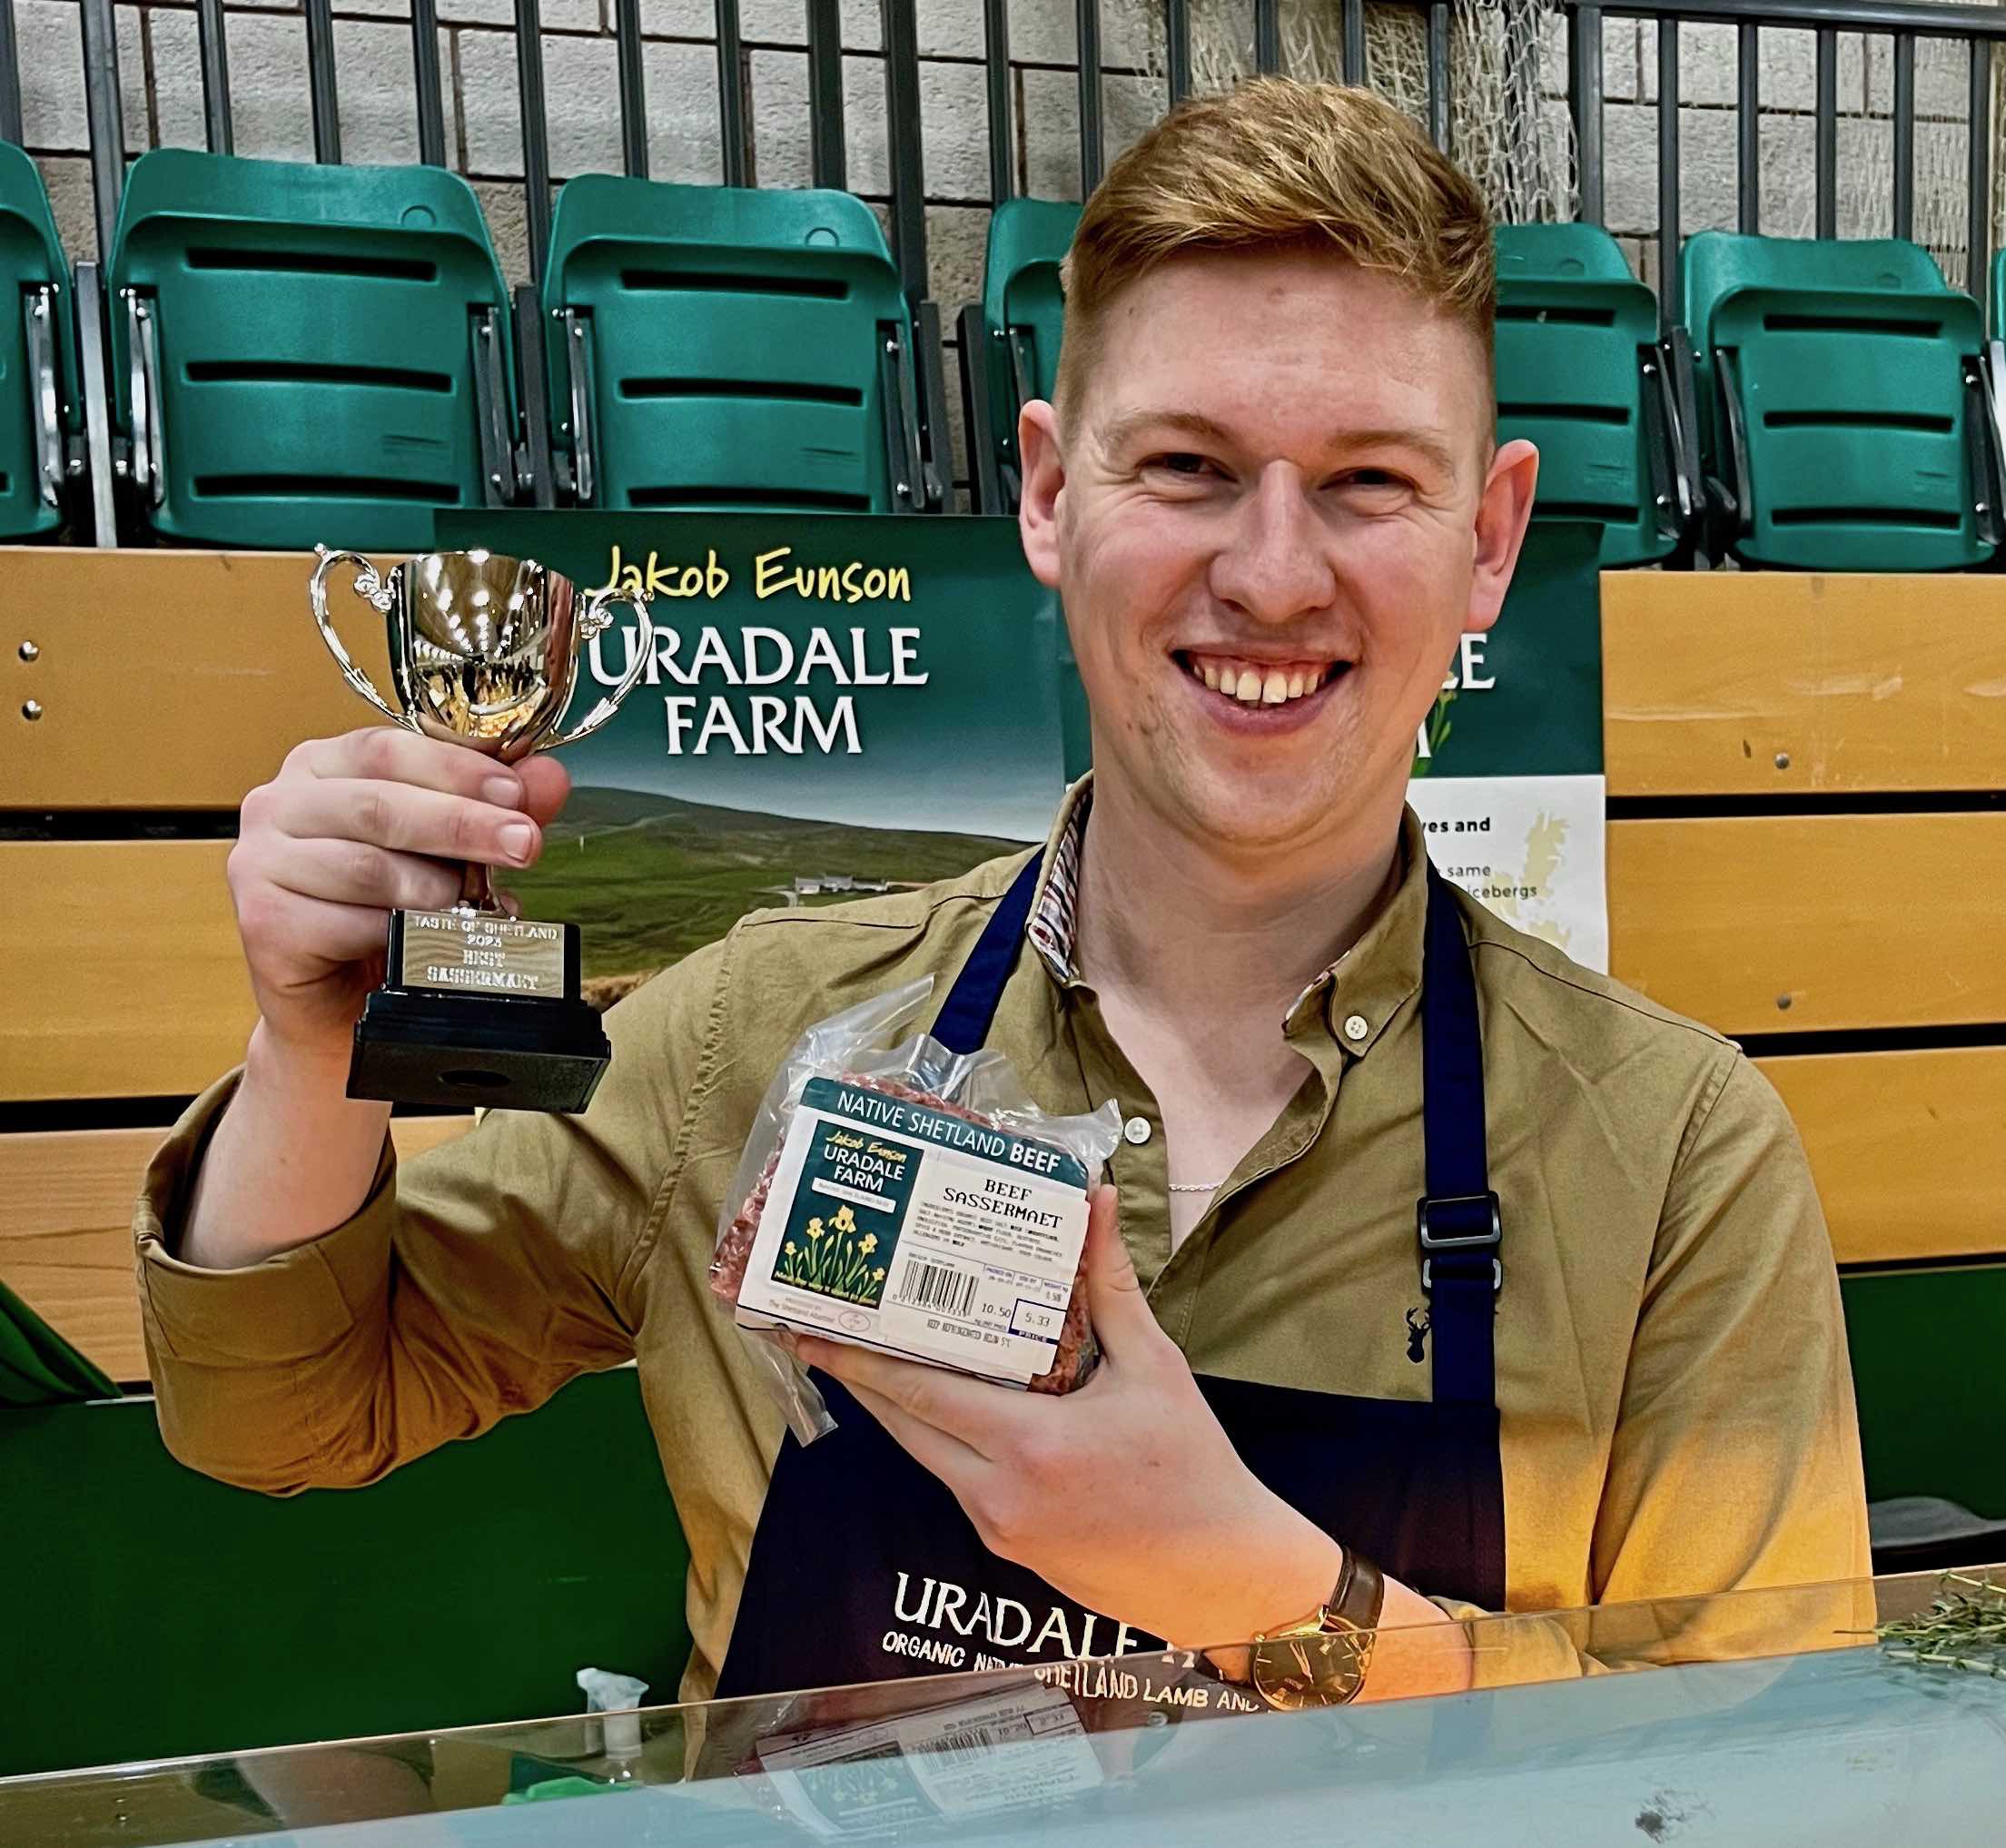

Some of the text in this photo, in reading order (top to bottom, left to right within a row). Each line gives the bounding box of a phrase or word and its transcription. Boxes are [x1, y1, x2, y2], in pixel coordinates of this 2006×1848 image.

[584, 545, 912, 603] Jakob Eunson
[589, 626, 929, 686] URADALE
[664, 695, 863, 755] FARM
[1455, 817, 1490, 833] and
[1448, 865, 1491, 877] same
[414, 915, 558, 941] TASTE OF SHETLAND
[463, 949, 506, 968] BEST
[825, 1131, 864, 1150] Jakob
[837, 1091, 1061, 1173] NATIVE SHETLAND BEEF
[824, 1144, 905, 1181] URADALE
[834, 1165, 884, 1192] FARM
[984, 1179, 1033, 1201] BEEF
[943, 1187, 1063, 1229] SASSERMAET
[981, 1302, 1012, 1319] 10.50
[1024, 1312, 1051, 1328] 5.33
[882, 1631, 965, 1667] ORGANIC
[1143, 1678, 1209, 1707] LAMB
